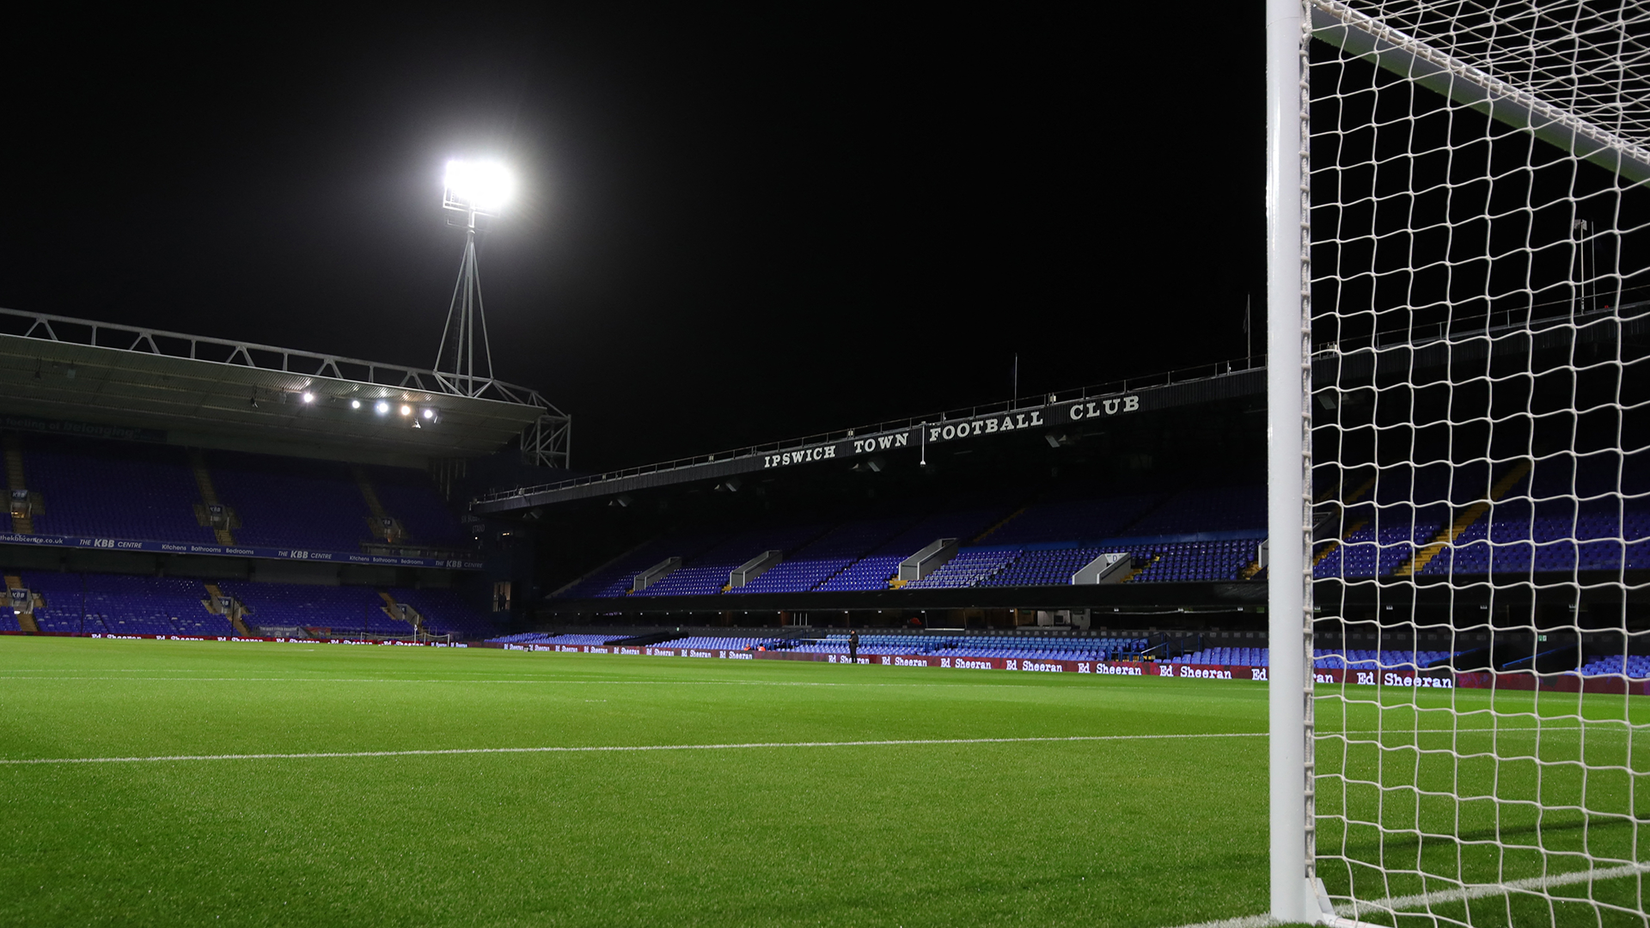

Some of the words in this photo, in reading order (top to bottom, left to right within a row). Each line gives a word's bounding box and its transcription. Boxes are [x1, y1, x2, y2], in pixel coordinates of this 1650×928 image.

[765, 445, 837, 468] IPSWICH
[855, 433, 910, 454] TOWN
[929, 411, 1044, 442] FOOTBALL
[1070, 395, 1140, 421] CLUB
[94, 538, 115, 548] KBB
[118, 541, 143, 549] CENTRE
[162, 543, 187, 551] Kitchens
[191, 545, 222, 553] Bathrooms
[226, 547, 254, 555] Bedrooms
[290, 550, 309, 559] KBB
[401, 558, 424, 566] Bedrooms
[446, 559, 462, 568] KBB
[729, 651, 753, 660] Sheeran
[828, 654, 837, 663] Ed
[882, 656, 891, 665] Ed
[895, 656, 928, 667] Sheeran
[941, 657, 951, 668] Ed
[955, 658, 992, 669] Sheeran
[1006, 660, 1018, 671] Ed
[1022, 660, 1063, 672] Sheeran
[1078, 662, 1091, 673] Ed
[1096, 663, 1142, 676] Sheeran
[1159, 664, 1174, 677] Ed
[1180, 666, 1232, 680] Sheeran
[1252, 668, 1268, 681] Ed
[1356, 672, 1375, 685] Ed
[1384, 673, 1453, 688] Sheeran
